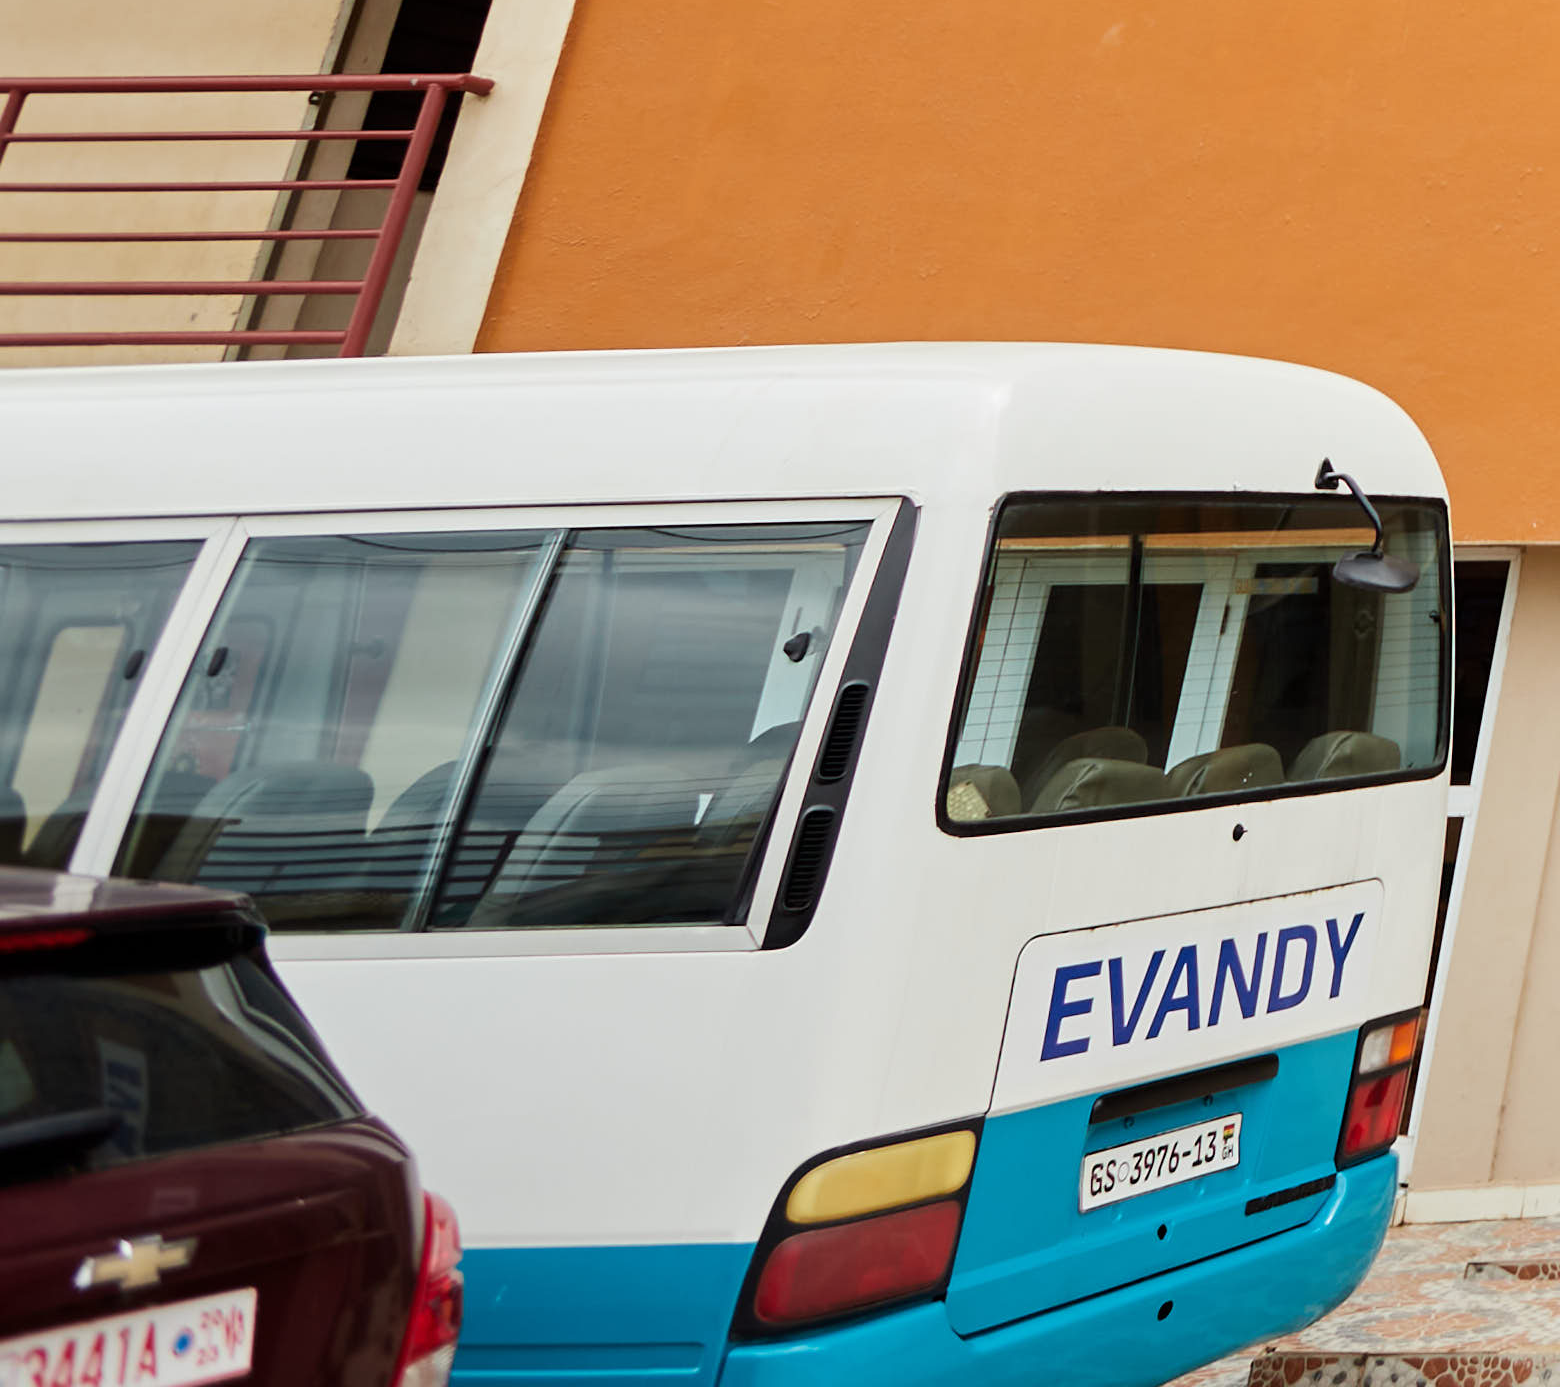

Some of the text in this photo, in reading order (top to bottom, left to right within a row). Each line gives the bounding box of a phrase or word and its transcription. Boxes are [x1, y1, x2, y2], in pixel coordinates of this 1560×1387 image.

[1039, 912, 1366, 1062] EVANDY
[1090, 1131, 1218, 1196] GS 3976-13
